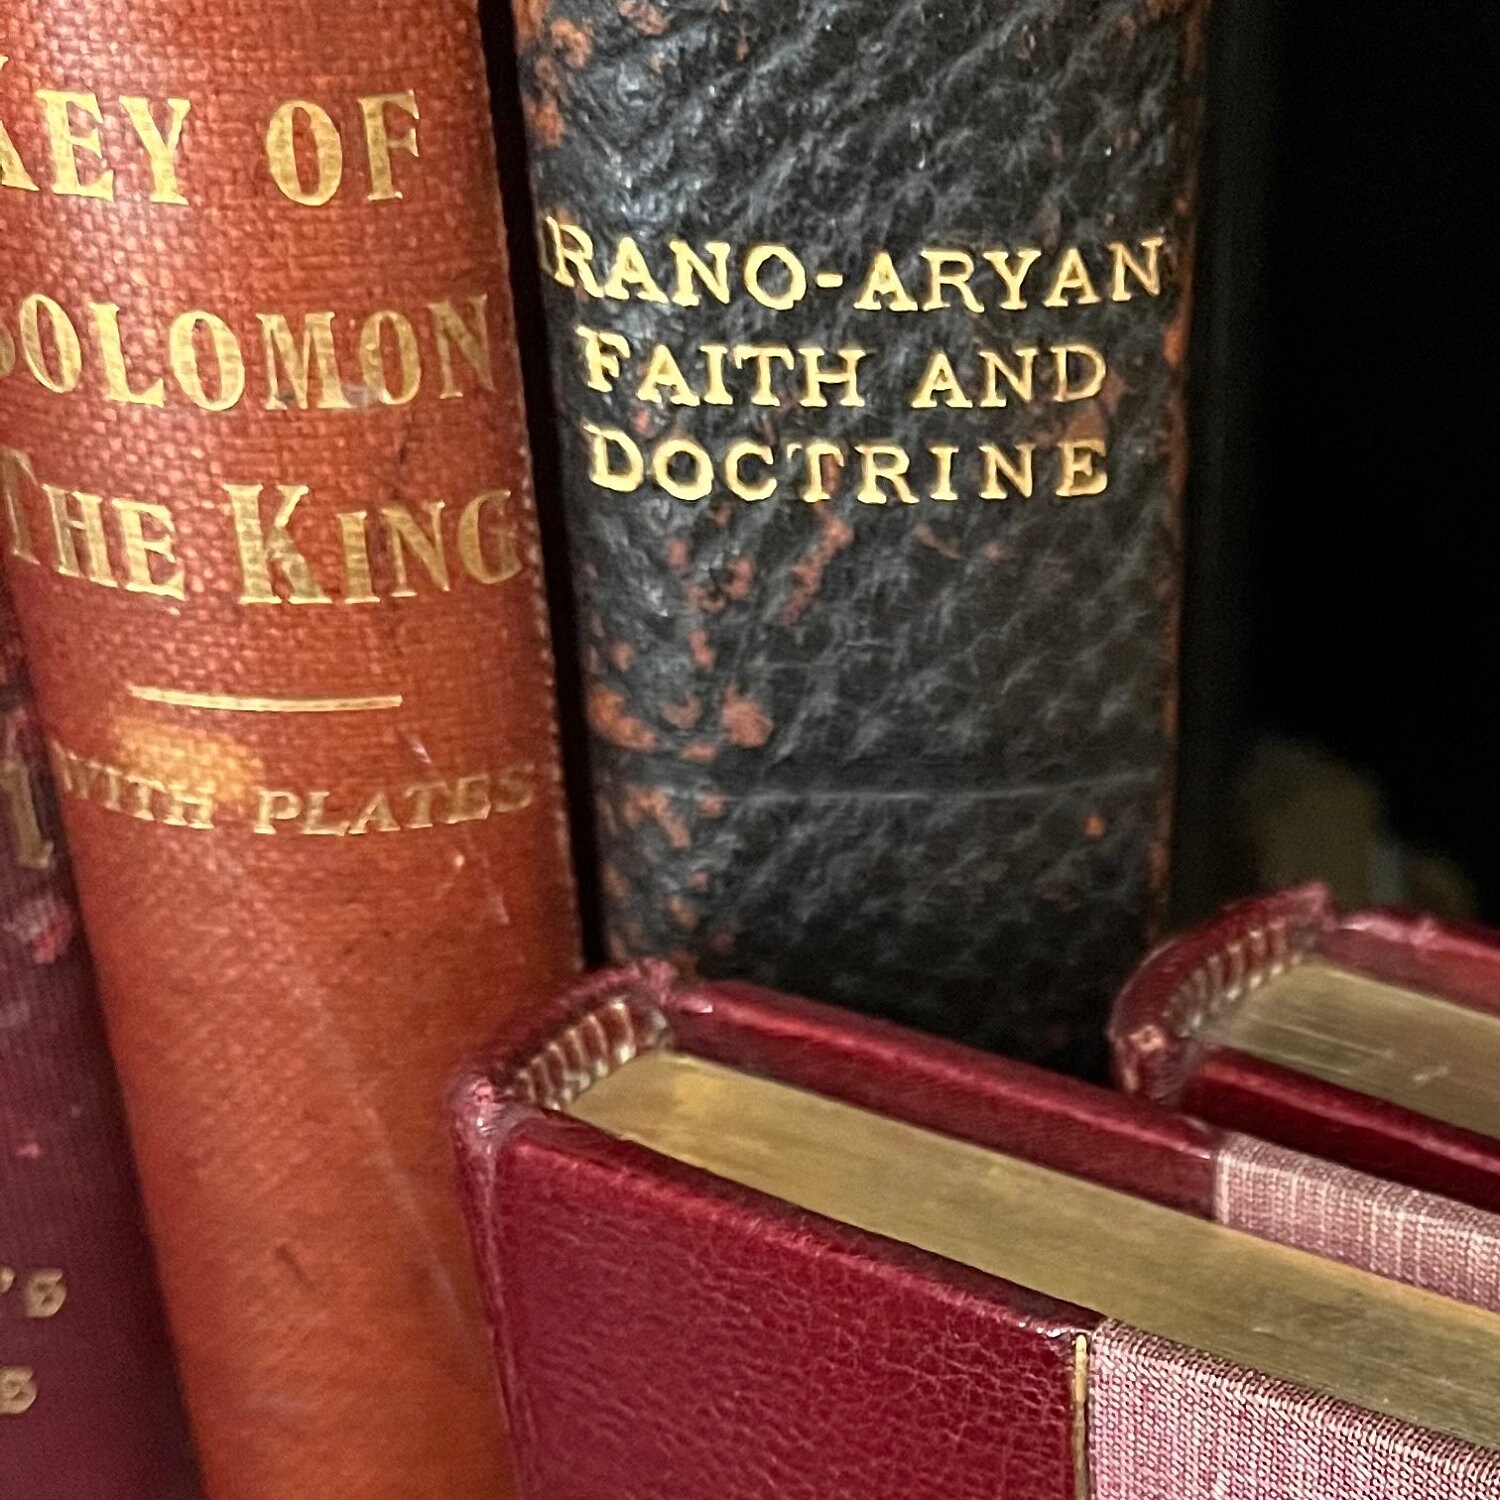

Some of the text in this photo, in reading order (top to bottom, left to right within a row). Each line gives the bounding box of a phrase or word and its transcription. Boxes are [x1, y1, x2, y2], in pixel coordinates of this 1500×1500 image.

[266, 89, 420, 206] OF
[0, 294, 496, 411] OLOMON
[575, 325, 1107, 408] FAITH AND
[583, 422, 1109, 504] DOCTRINE
[222, 483, 523, 604] KING
[253, 763, 535, 837] PLATES
